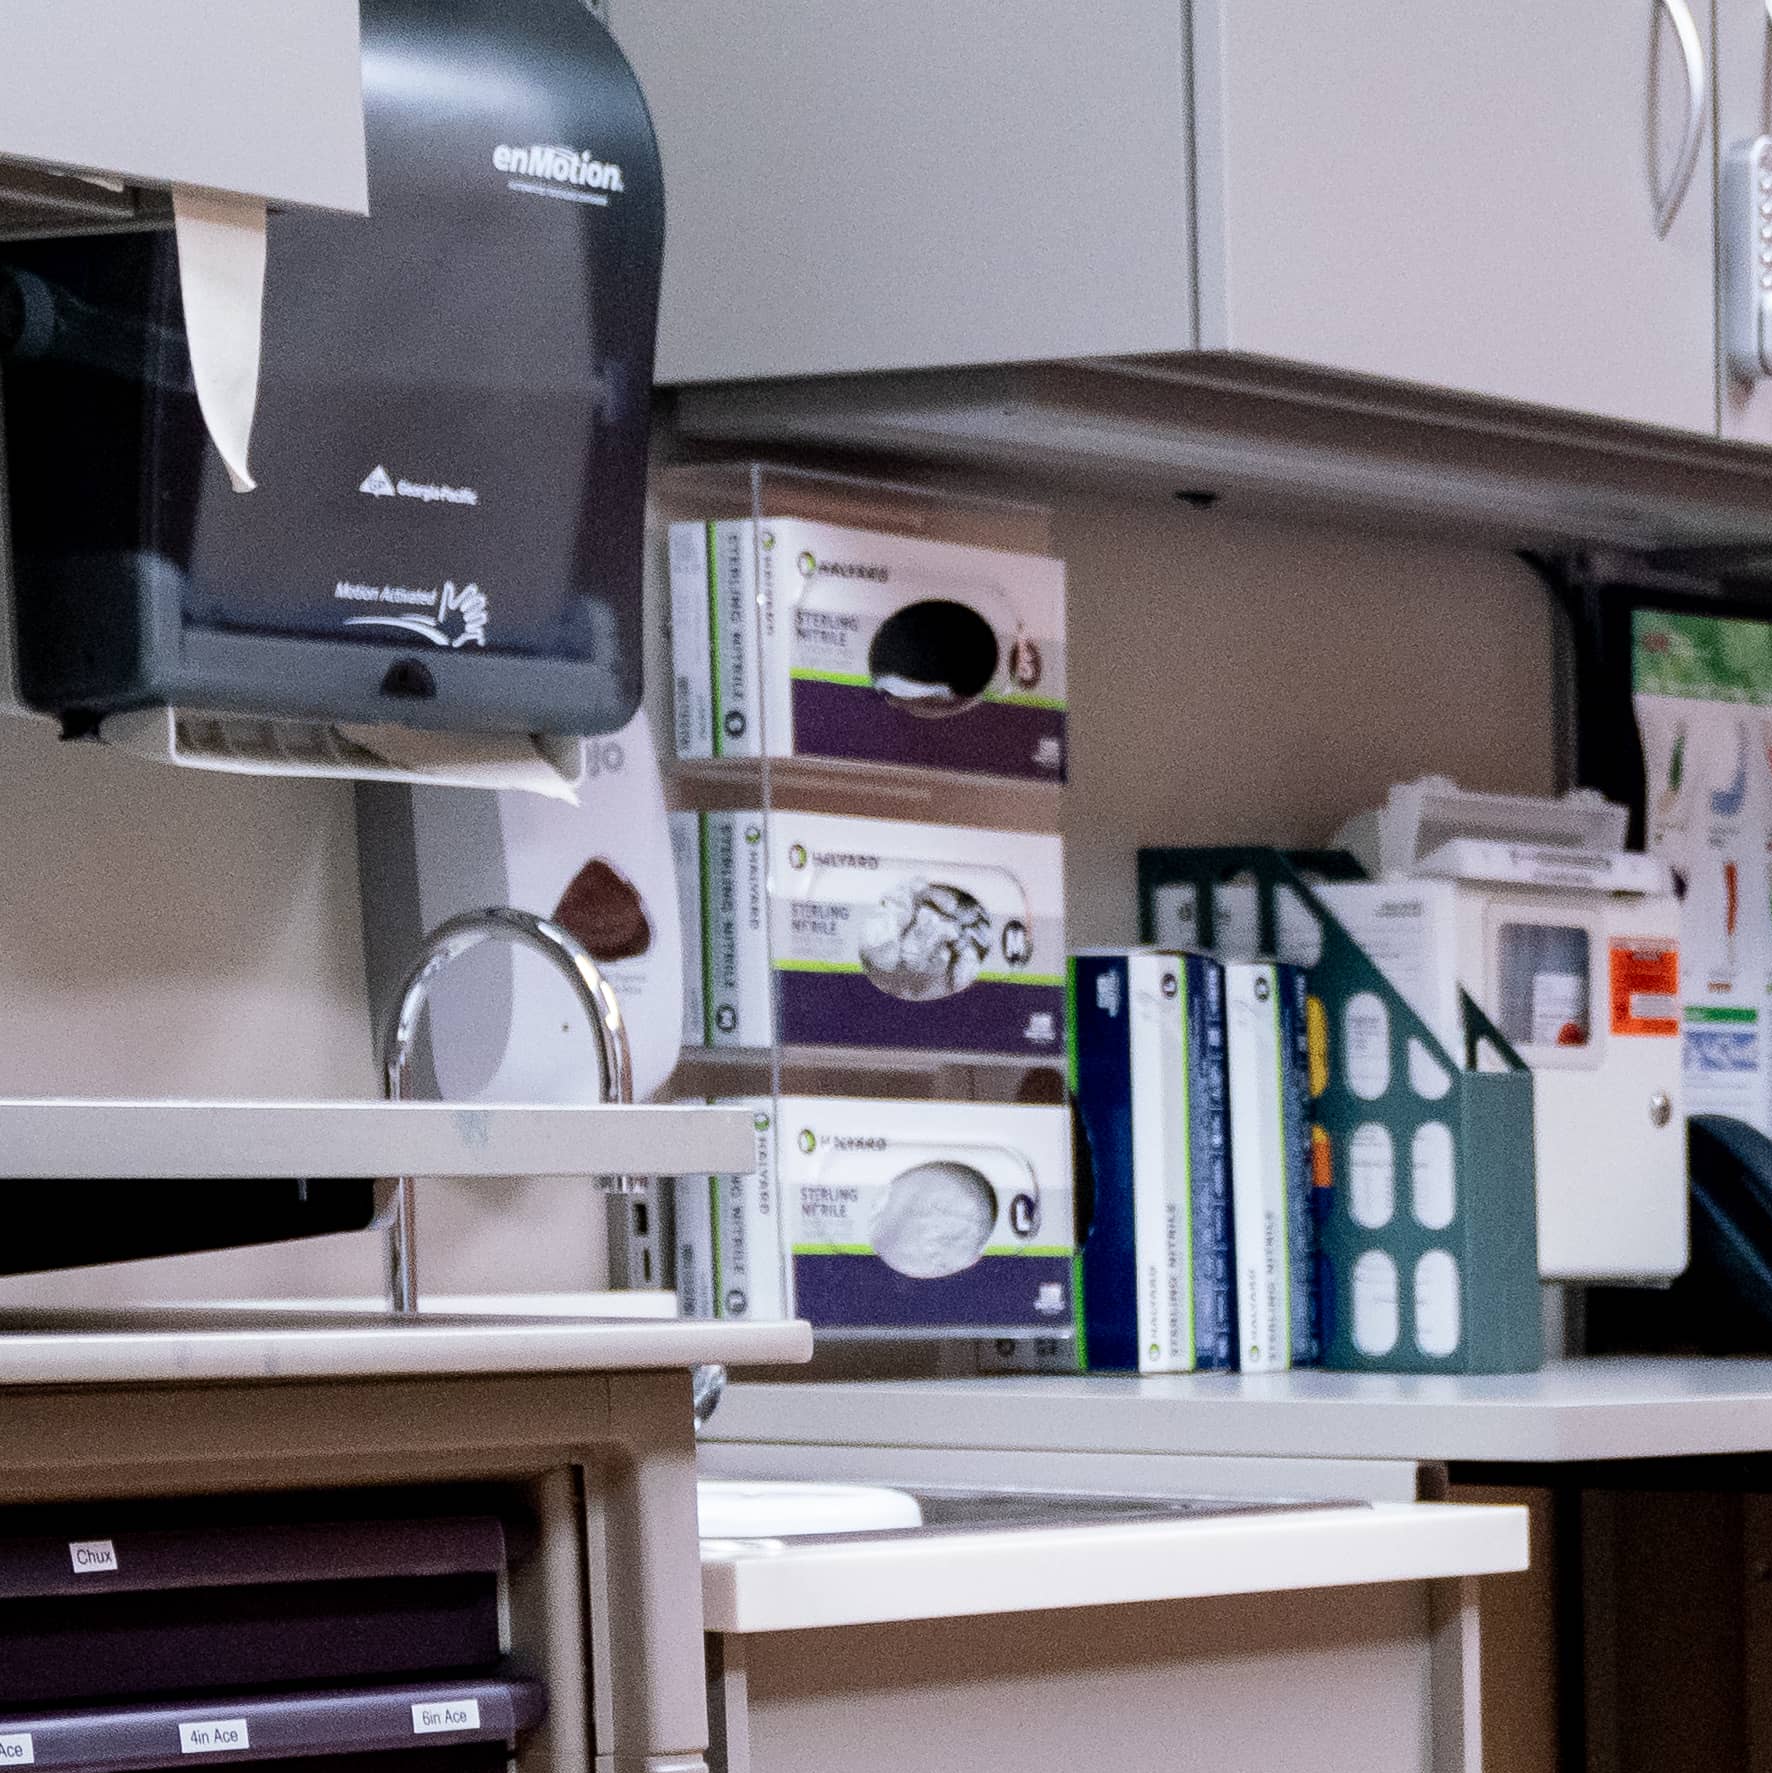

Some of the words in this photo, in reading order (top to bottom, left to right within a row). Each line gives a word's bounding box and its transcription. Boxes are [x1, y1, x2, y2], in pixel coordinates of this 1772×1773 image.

[492, 143, 623, 192] enMotion
[77, 1548, 113, 1565] Chux
[422, 1711, 441, 1726] 6in
[445, 1709, 467, 1724] Ace
[190, 1729, 209, 1745] 4in
[214, 1728, 239, 1744] Ace
